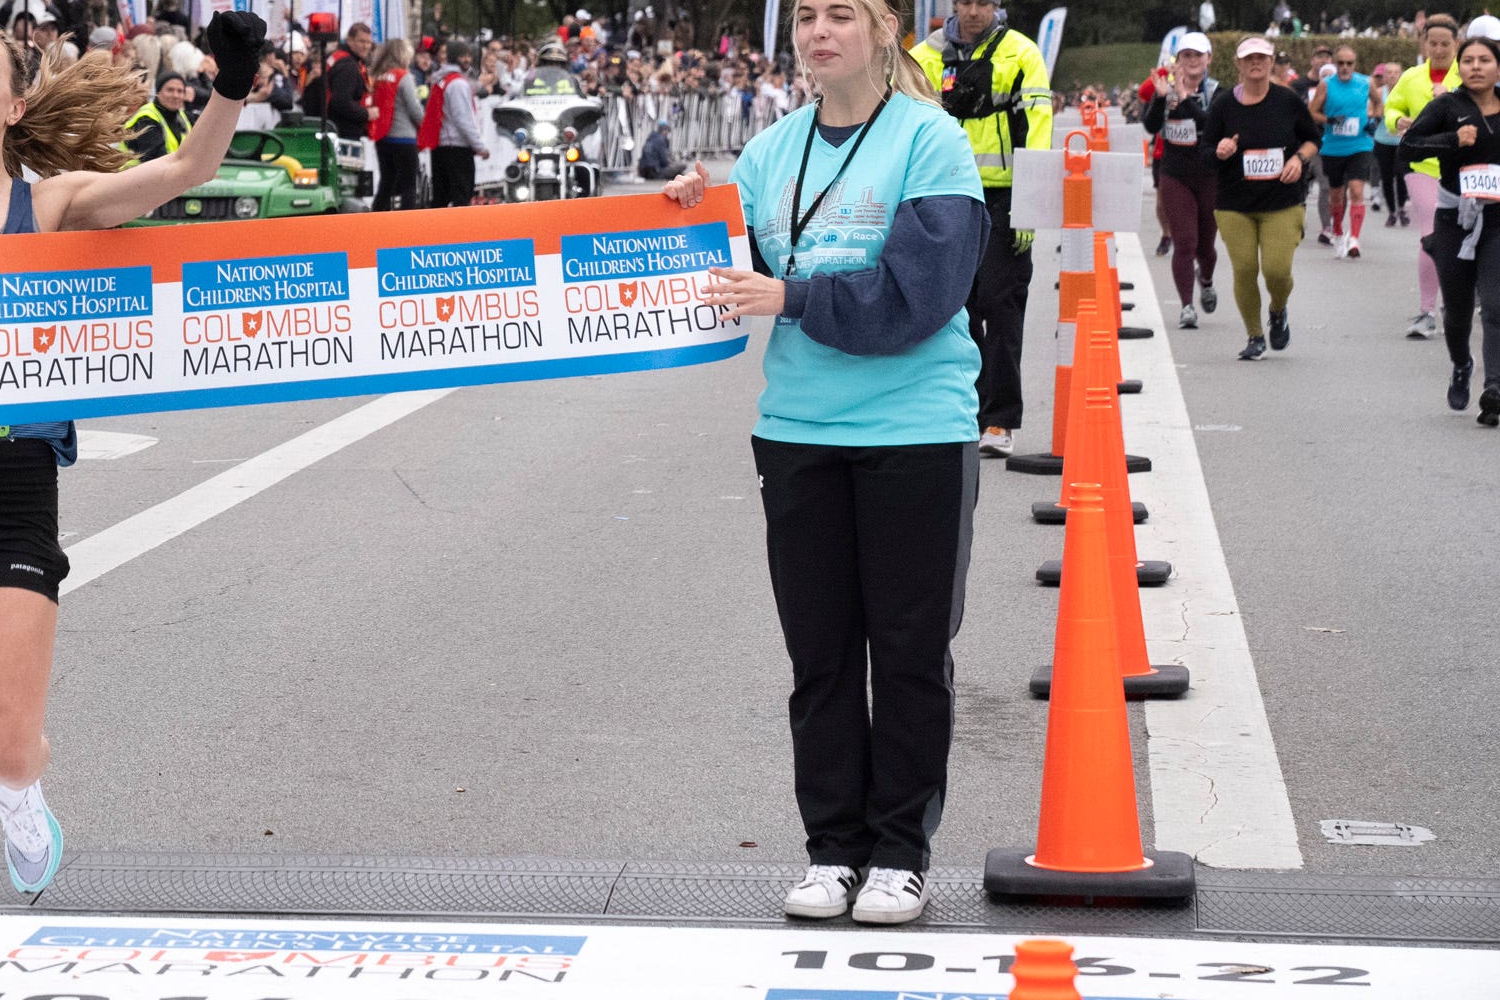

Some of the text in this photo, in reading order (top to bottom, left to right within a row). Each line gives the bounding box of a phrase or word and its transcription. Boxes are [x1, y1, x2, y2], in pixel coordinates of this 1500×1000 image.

[1246, 160, 1275, 172] 10222
[592, 234, 688, 256] NATIONWIDE
[410, 247, 503, 269] NATIONWIDE
[565, 249, 728, 277] CHILDREN'S HOSPITAL
[217, 260, 314, 284] NATIONWIDE
[381, 264, 533, 292] CHILDREN'S HOSPITAL
[2, 275, 117, 297] NATIONWIDE
[186, 277, 346, 307] CHILDREN'S HOSPITAL
[71, 295, 149, 315] HOSPITAL
[380, 320, 543, 360] MARATHON
[182, 336, 353, 377] MARATHON
[10, 563, 44, 576] patagonia
[39, 935, 565, 955] CHILDREN'S HOSPITAL
[153, 928, 469, 942] NATIONWIDE
